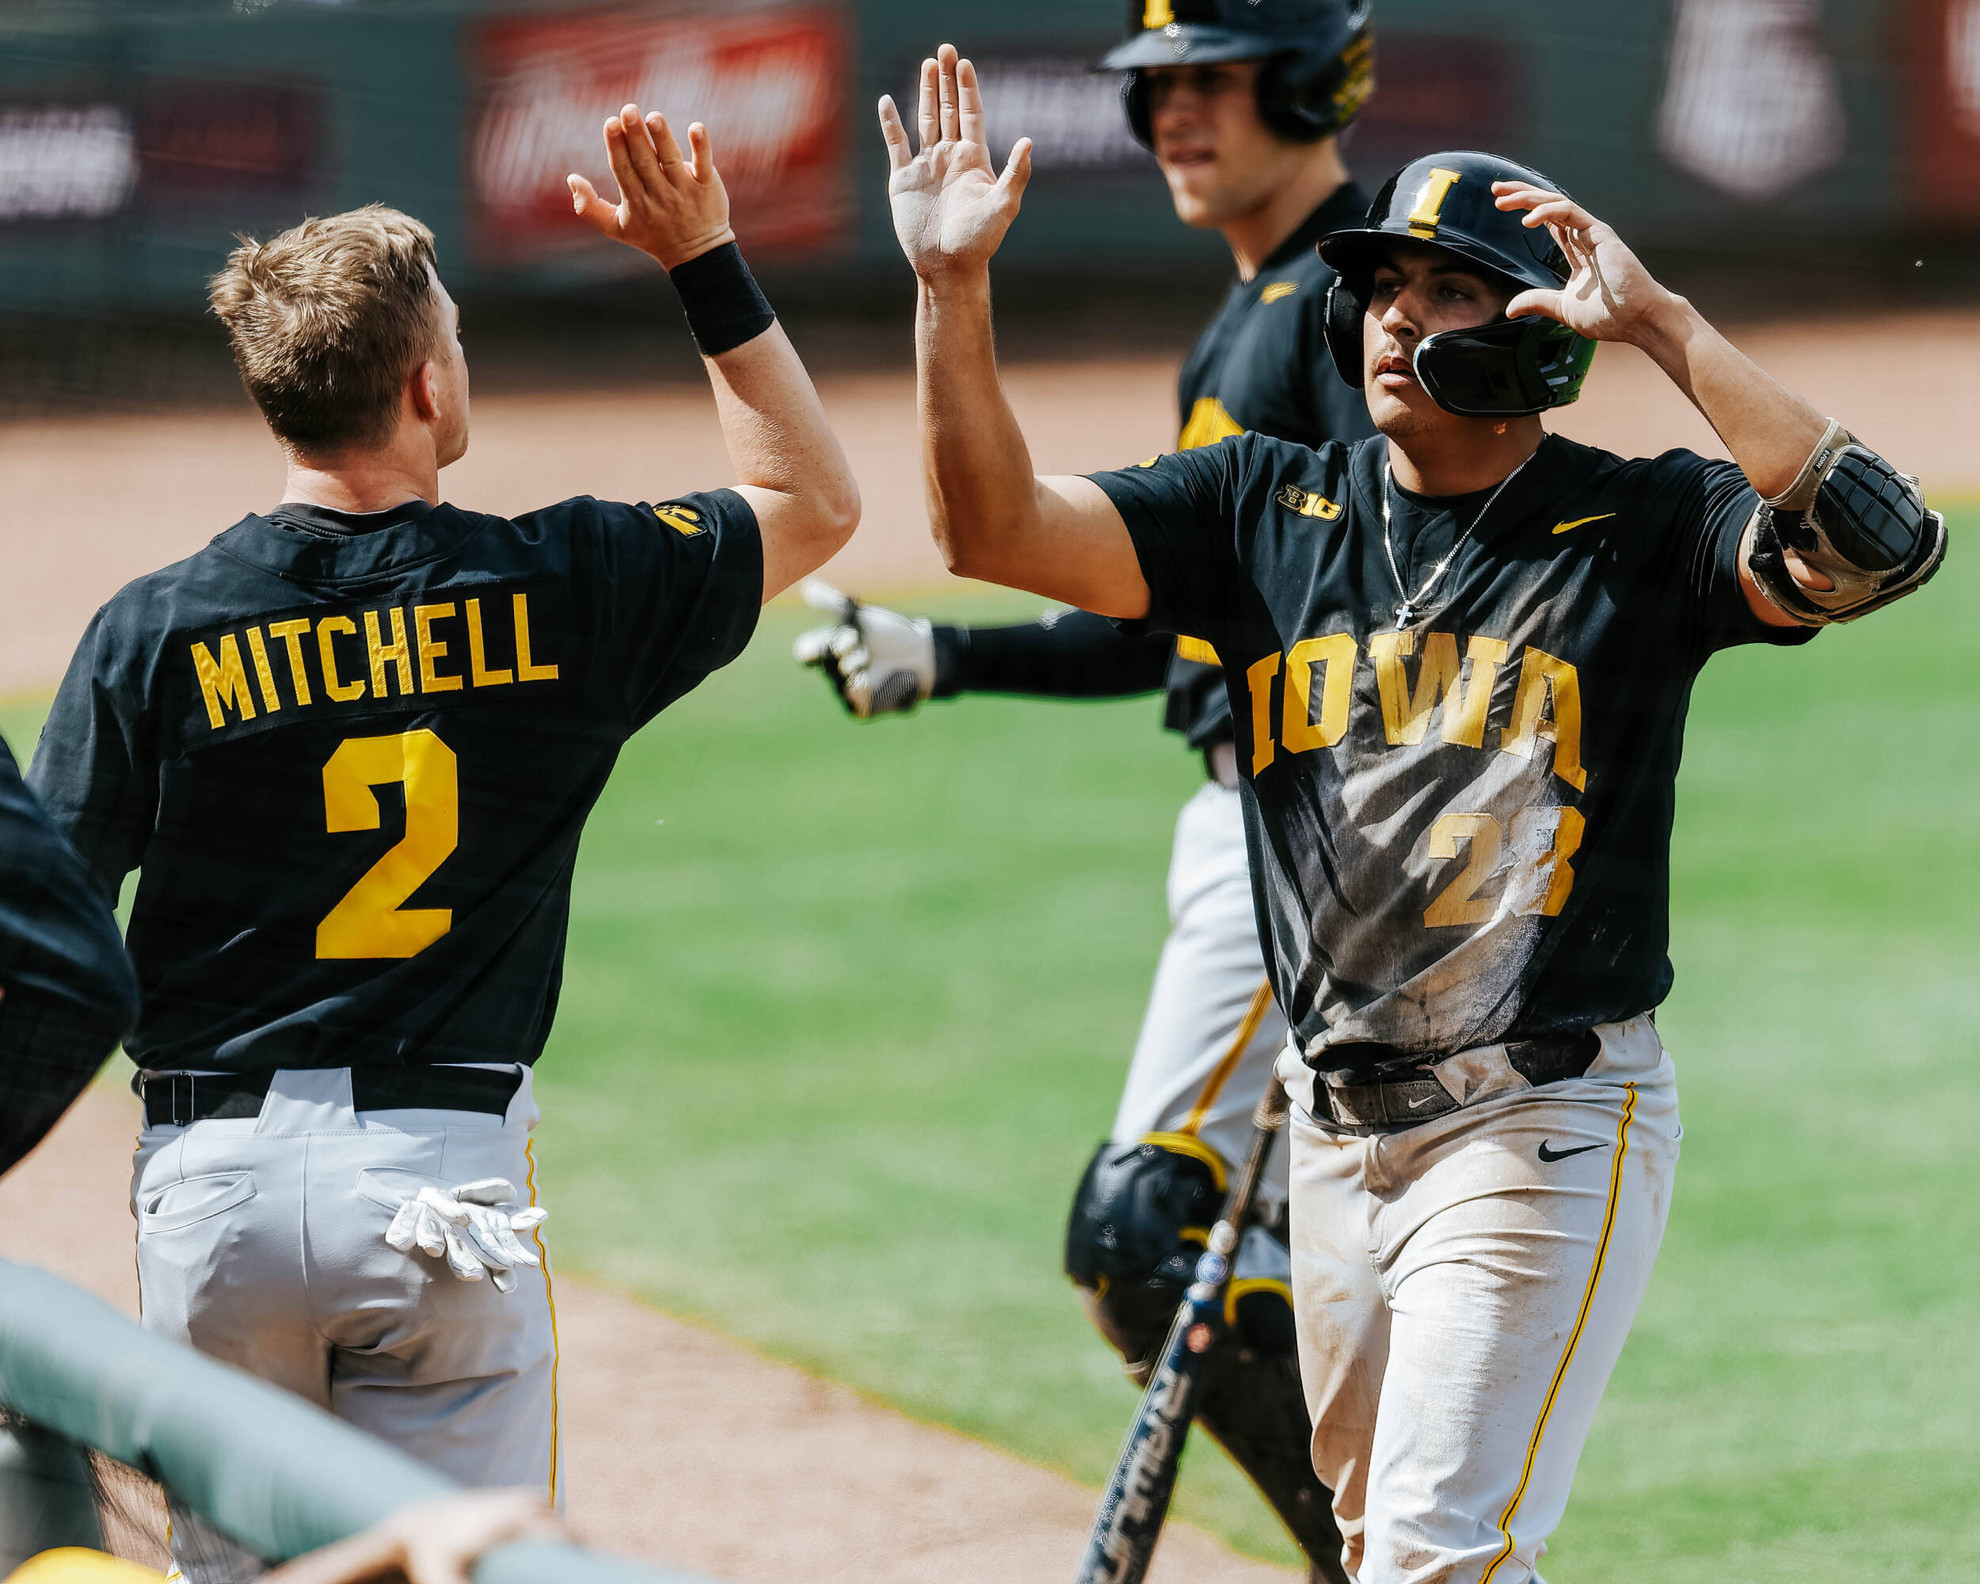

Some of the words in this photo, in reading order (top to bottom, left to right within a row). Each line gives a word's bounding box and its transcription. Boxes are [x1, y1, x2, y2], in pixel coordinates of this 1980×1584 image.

[1408, 167, 1462, 226] I
[190, 593, 559, 729] MITCHELL
[1246, 631, 1588, 793] IOWA
[315, 728, 459, 960] 2
